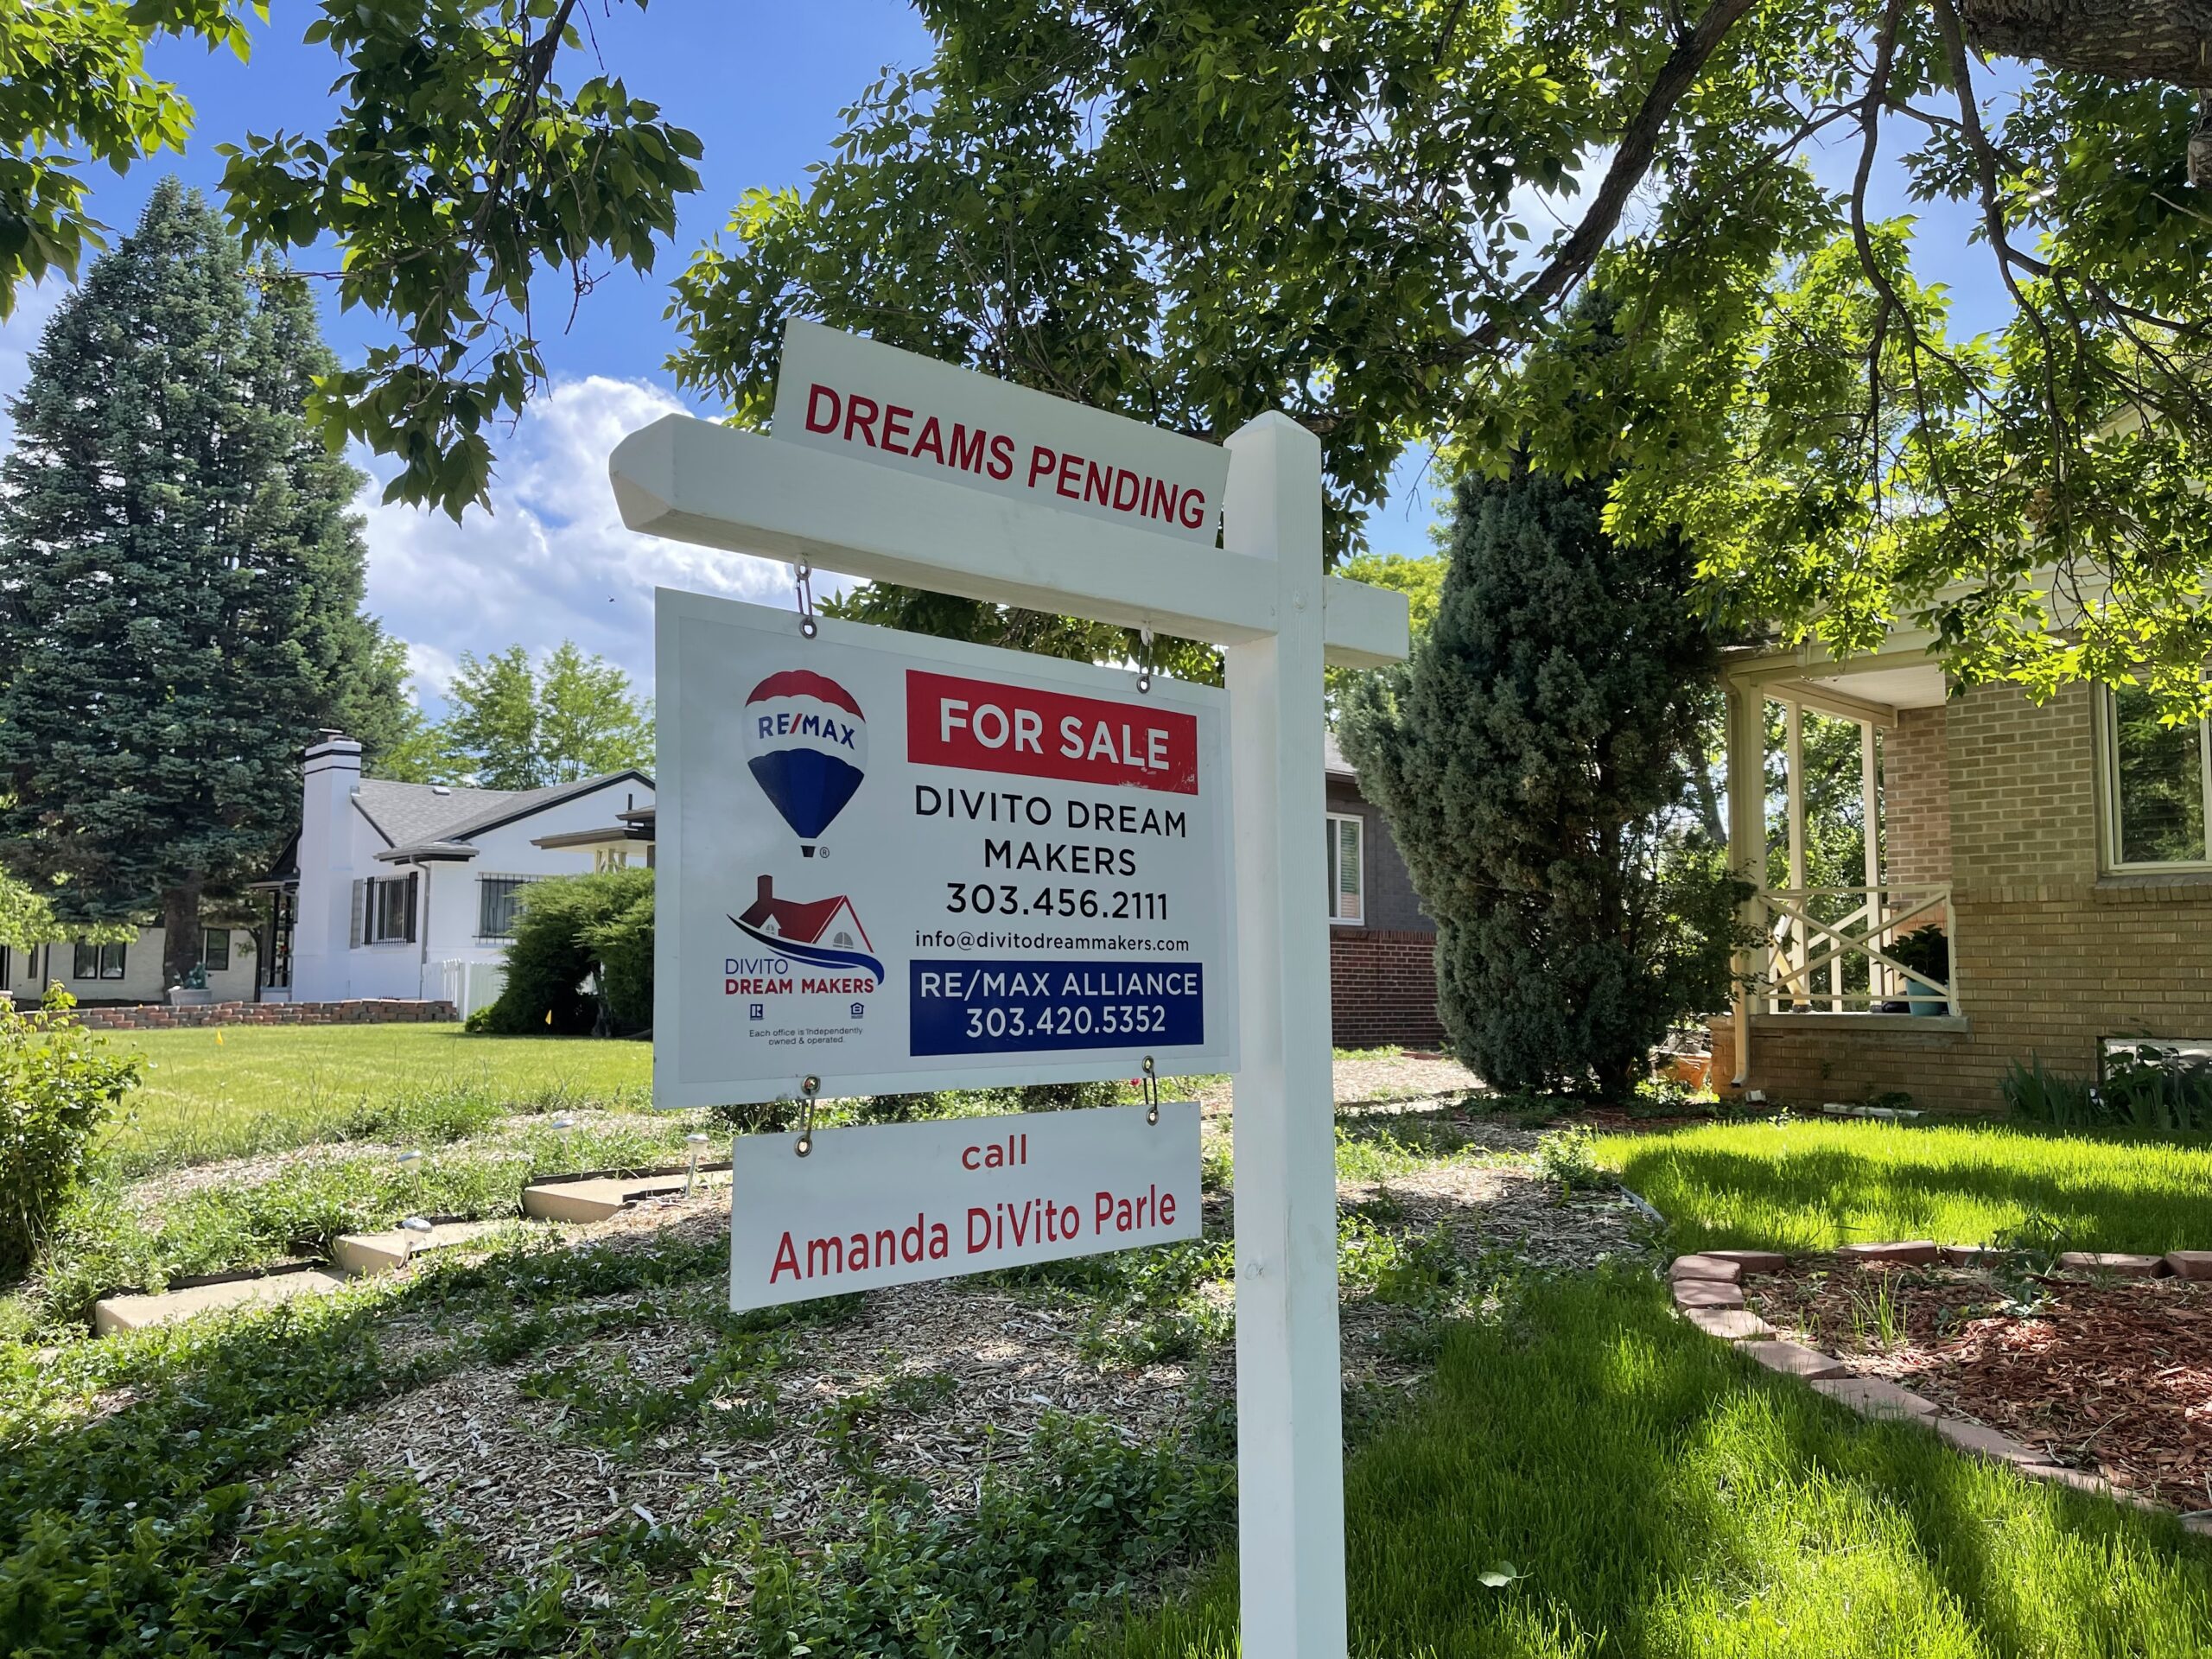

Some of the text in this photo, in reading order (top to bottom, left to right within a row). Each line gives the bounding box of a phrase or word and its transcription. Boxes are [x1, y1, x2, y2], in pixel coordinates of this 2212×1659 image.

[805, 384, 1205, 529] DREAMS PENDING
[758, 712, 856, 751] RE/MAX
[940, 697, 1169, 770] FOR SALE
[915, 784, 1186, 838] DIVITO DREAM
[984, 838, 1136, 877] MAKERS
[946, 881, 1166, 920] 303.456.2111
[915, 930, 1189, 951] info@divitodreammakers.com
[725, 958, 789, 975] DIVITO
[725, 977, 874, 995] DREAM MAKERS
[920, 969, 1198, 1001] RE/MAX ALLIANCE
[749, 1029, 771, 1038] Each
[772, 1028, 796, 1037] office
[965, 1004, 1166, 1038] 303.420.5352
[768, 1037, 797, 1046] owned
[962, 1134, 1027, 1170] call
[770, 1185, 1176, 1284] Amanda DiVito Parle
